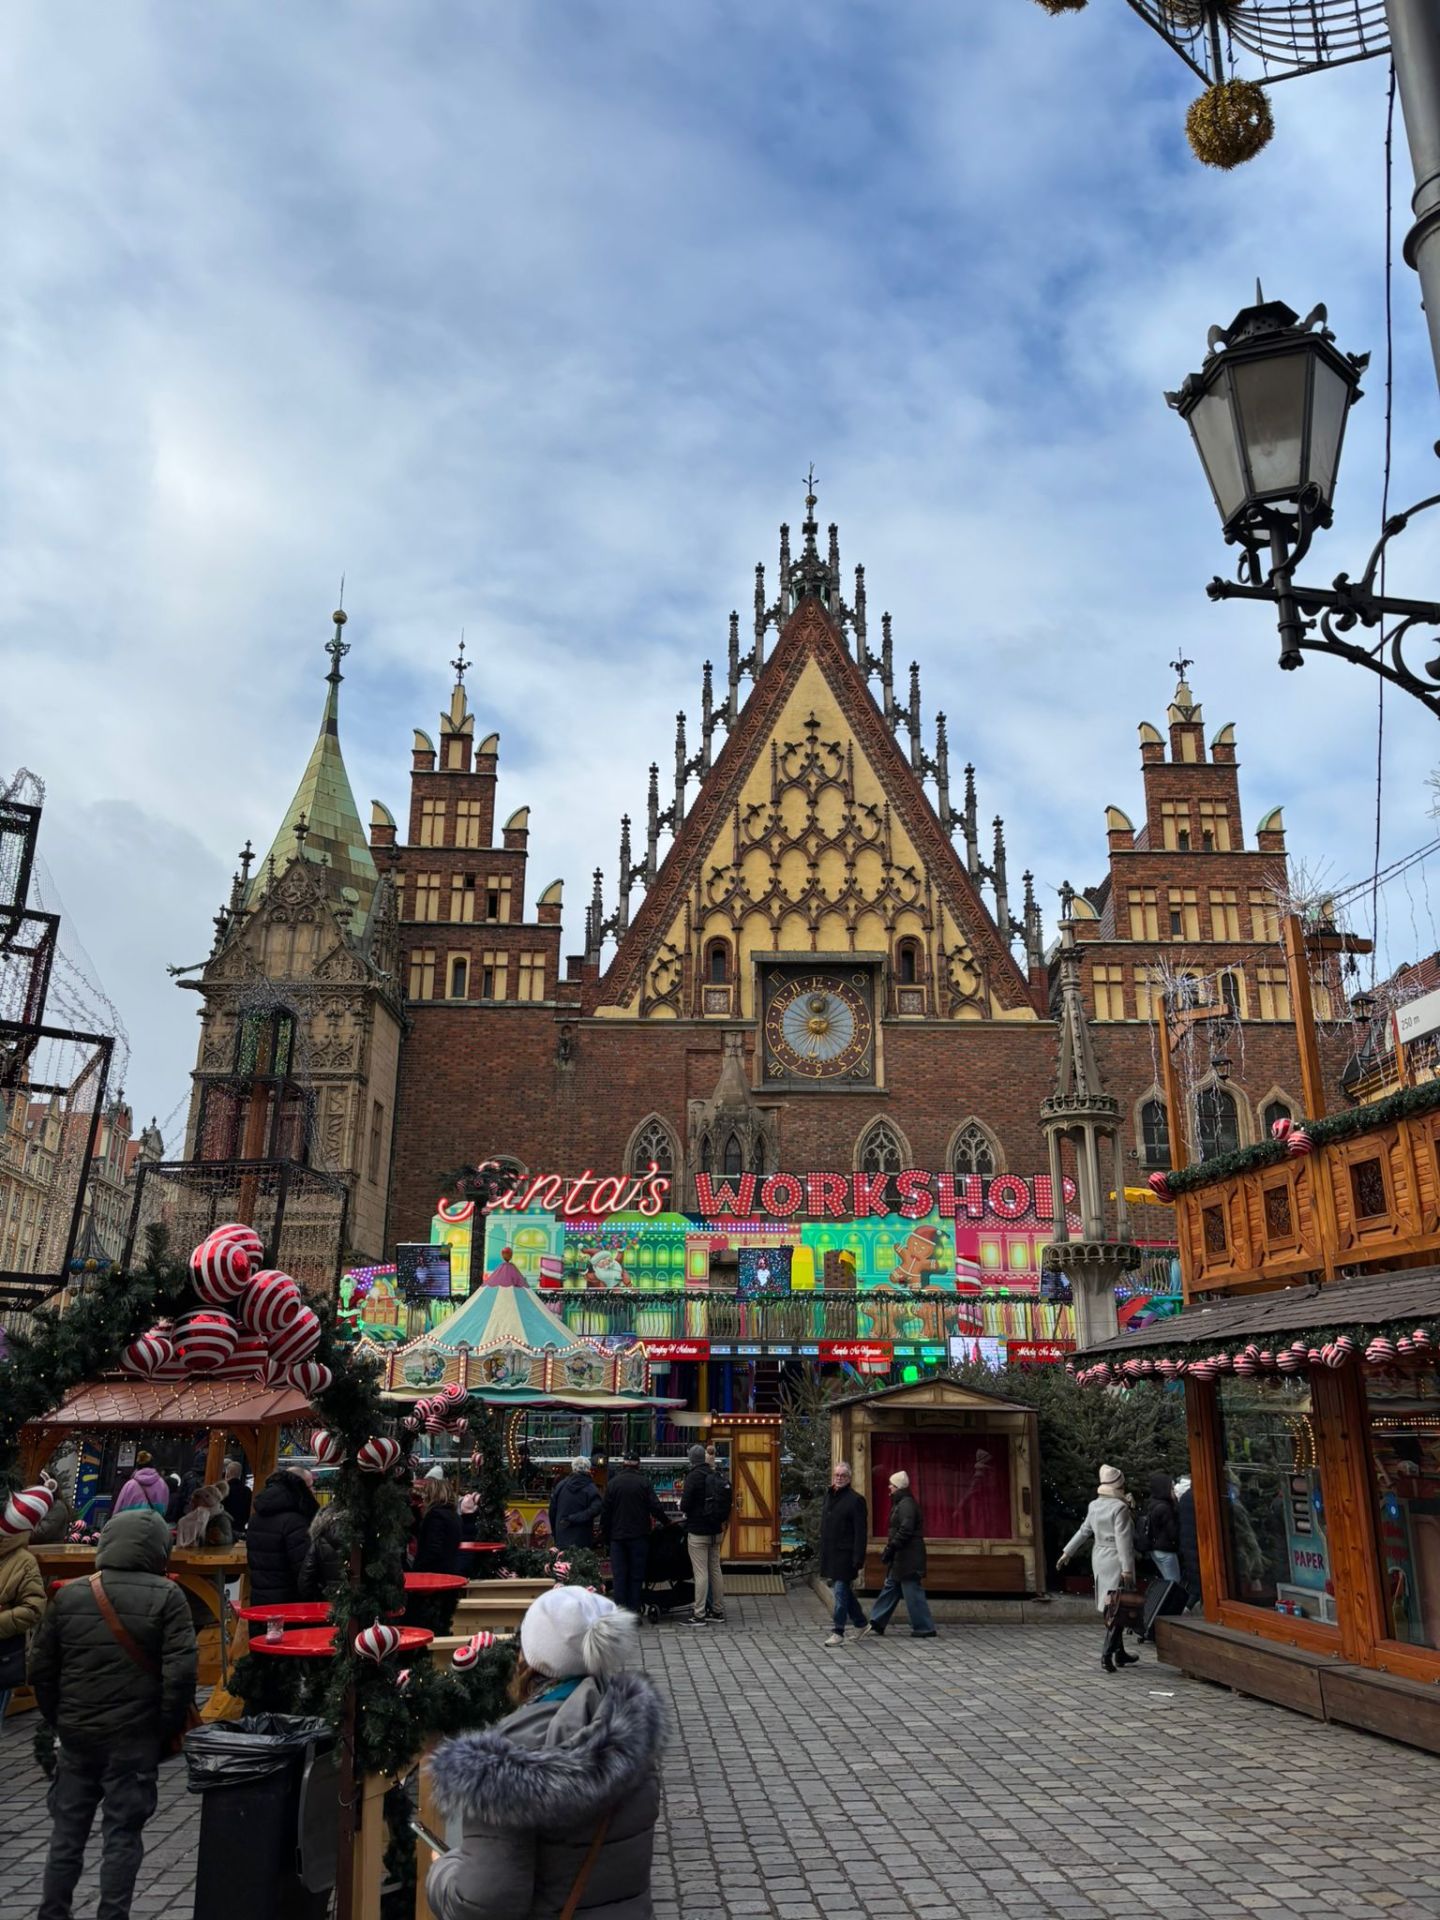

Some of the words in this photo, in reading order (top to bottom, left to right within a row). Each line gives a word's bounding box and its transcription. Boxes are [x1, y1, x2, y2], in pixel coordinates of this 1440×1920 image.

[812, 976, 824, 988] 12
[773, 997, 786, 1010] 10
[693, 1167, 1078, 1220] WORKSHOP
[1294, 1551, 1324, 1570] PAPER
